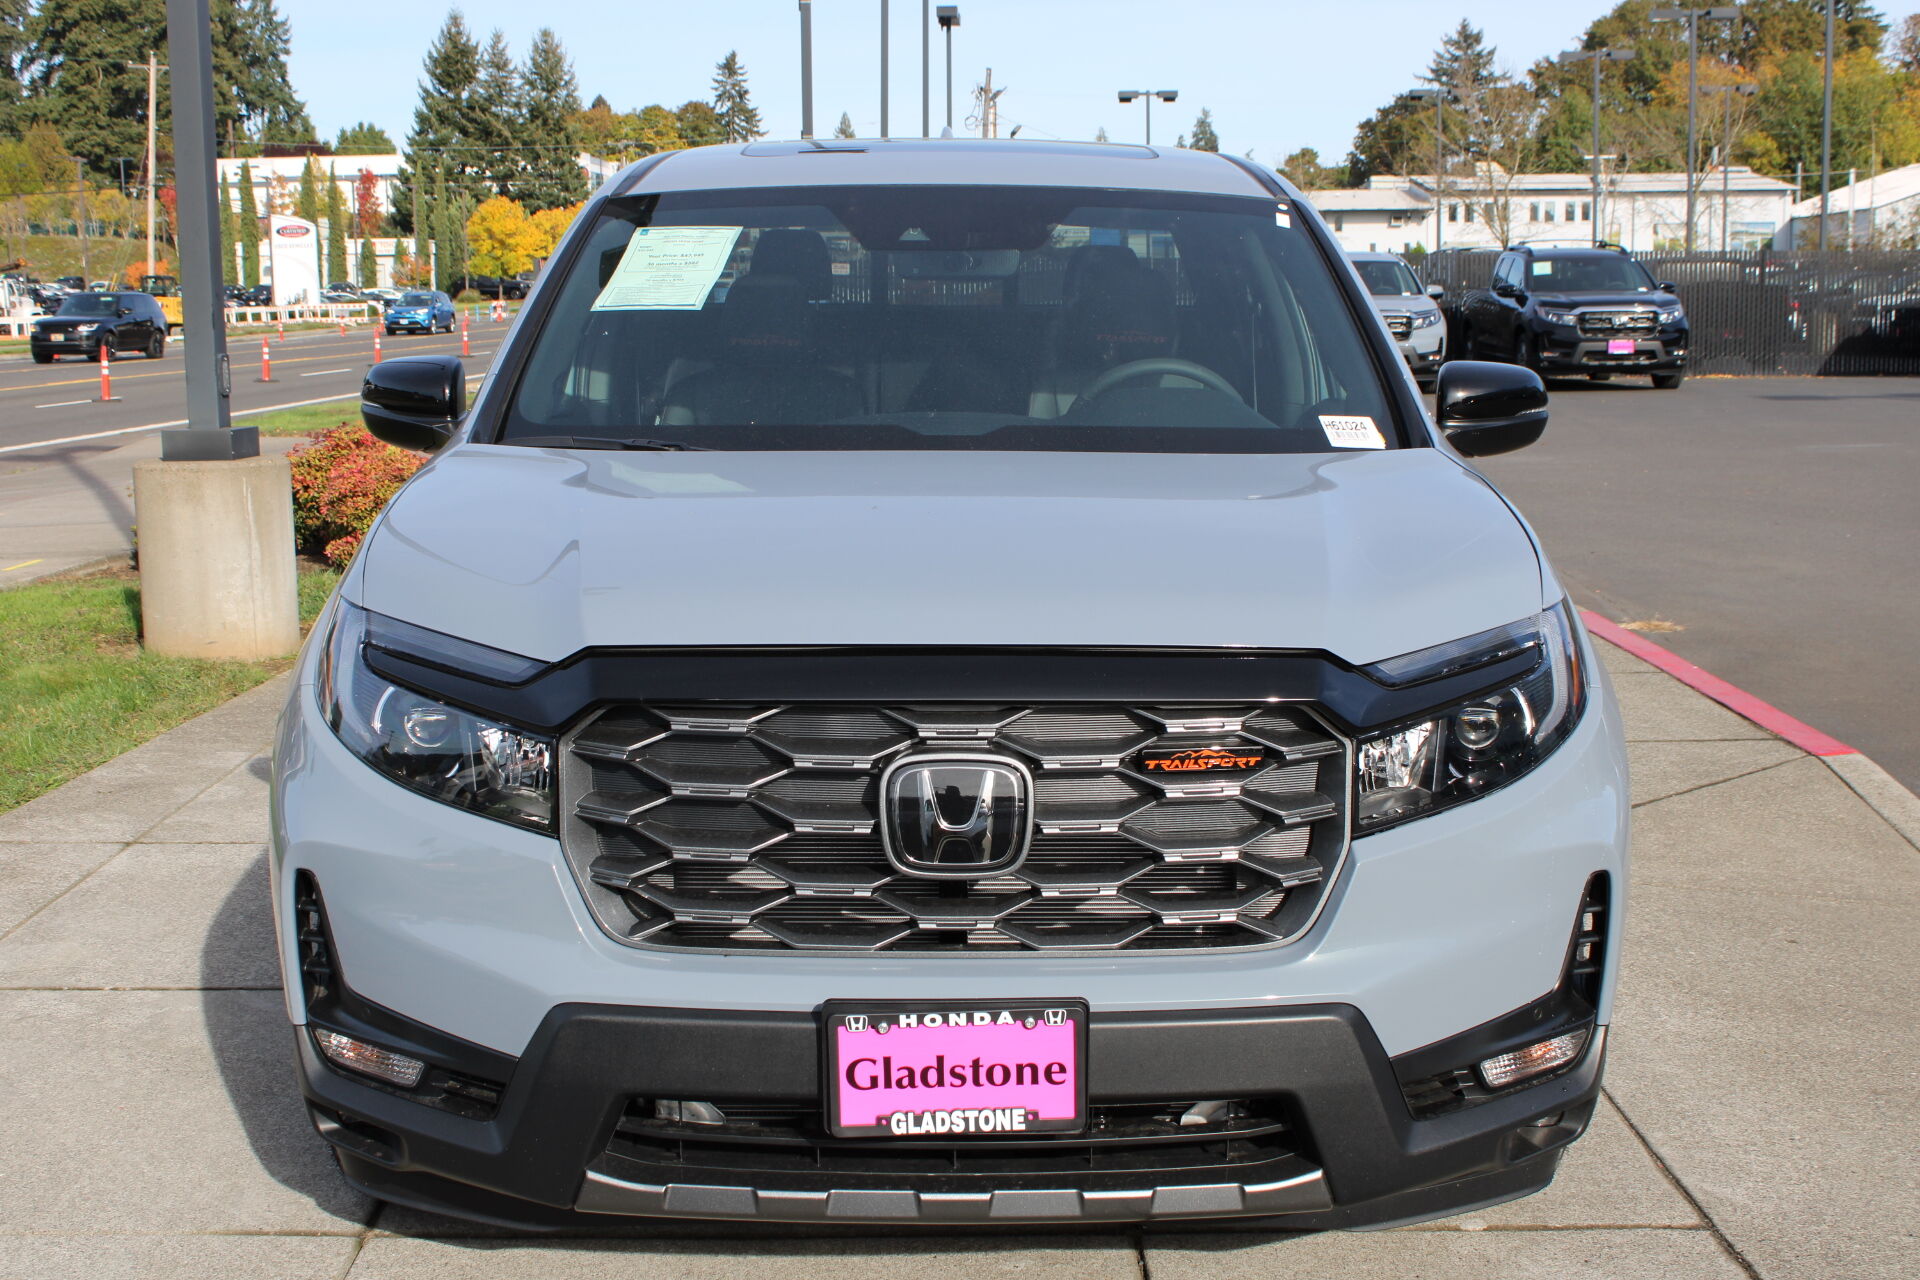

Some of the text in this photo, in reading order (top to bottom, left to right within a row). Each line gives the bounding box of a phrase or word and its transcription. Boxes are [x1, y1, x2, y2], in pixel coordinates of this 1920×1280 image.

[1323, 420, 1367, 431] H61024
[1145, 756, 1262, 771] TRAILSPORT
[898, 1011, 1016, 1029] HONDA
[845, 1055, 1068, 1091] Gladstone
[890, 1108, 1027, 1135] GLADSTONE
